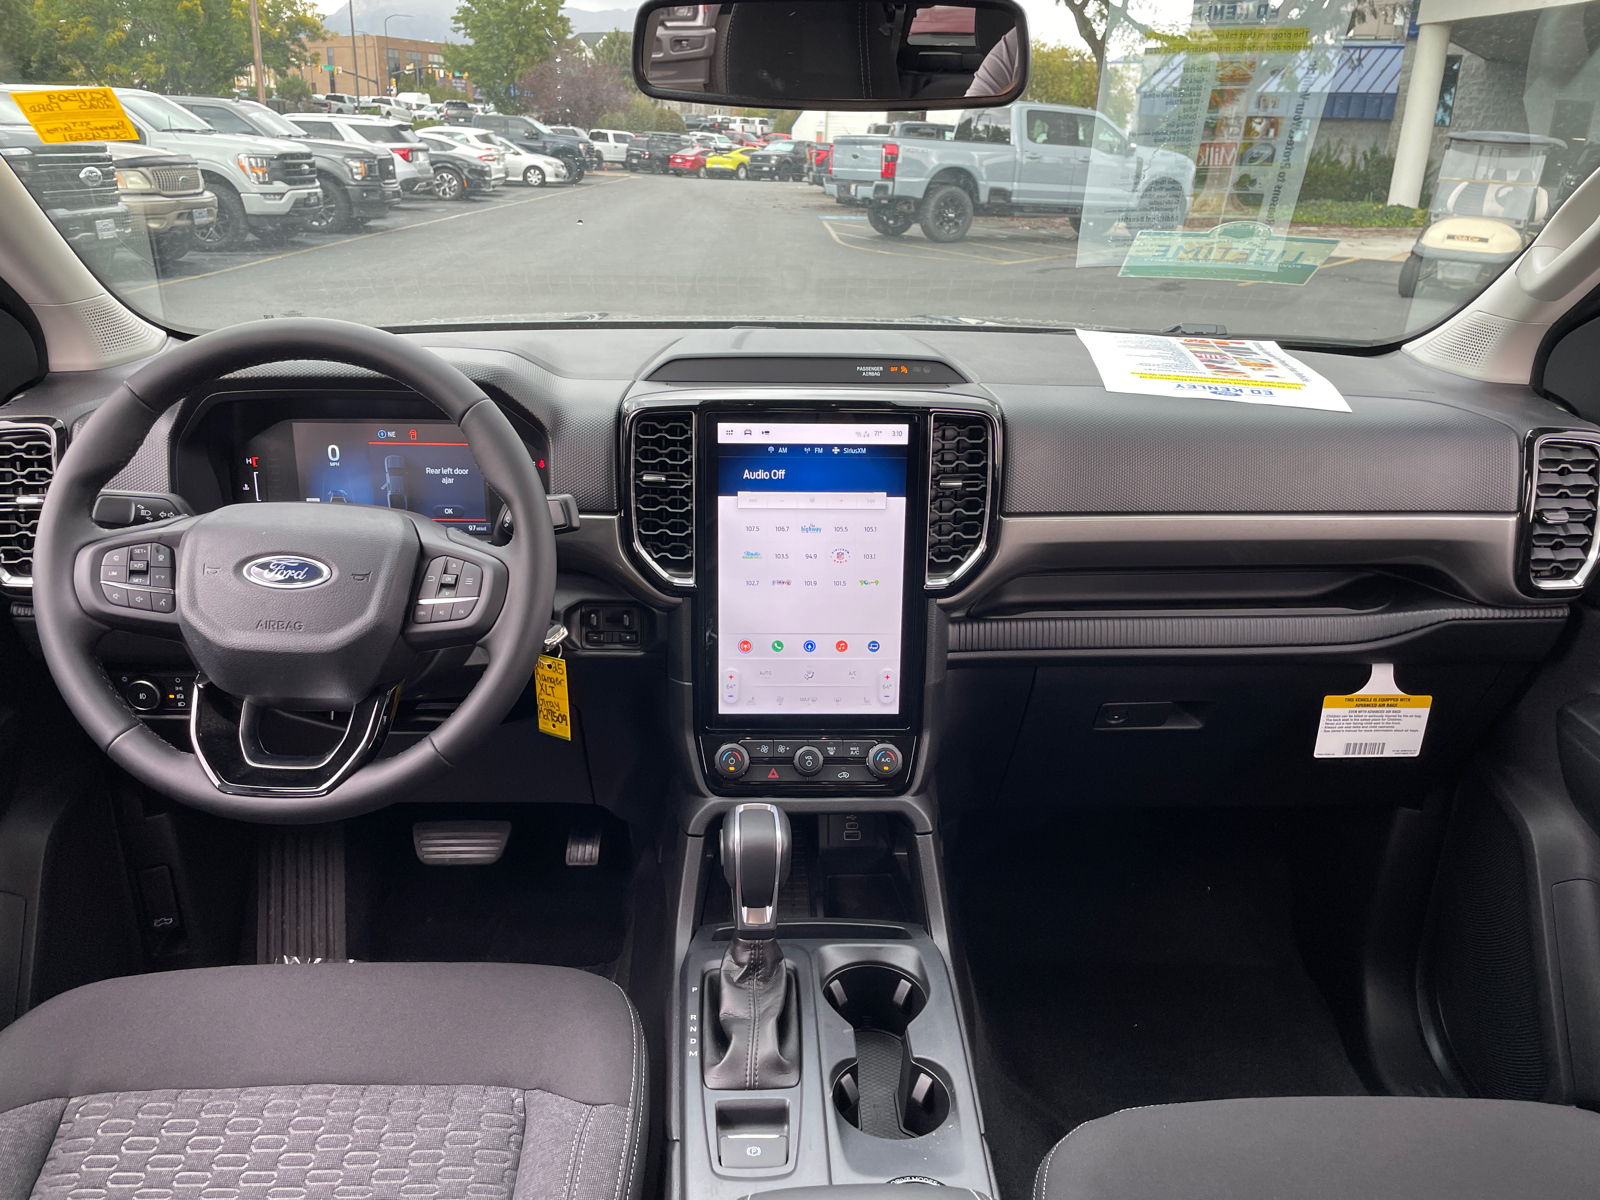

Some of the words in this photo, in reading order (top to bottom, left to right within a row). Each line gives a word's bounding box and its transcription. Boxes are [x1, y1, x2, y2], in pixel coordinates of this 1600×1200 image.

[1176, 384, 1243, 393] KENLEY
[327, 444, 340, 461] 0
[426, 467, 440, 475] Rear
[441, 467, 453, 475] left
[454, 467, 469, 475] door
[743, 469, 770, 479] Audio
[771, 469, 786, 480] Off
[263, 561, 308, 580] Ford
[256, 620, 303, 631] AIRBAG
[536, 669, 564, 686] Ranger
[540, 681, 555, 697] XLT
[538, 693, 560, 711] Gray
